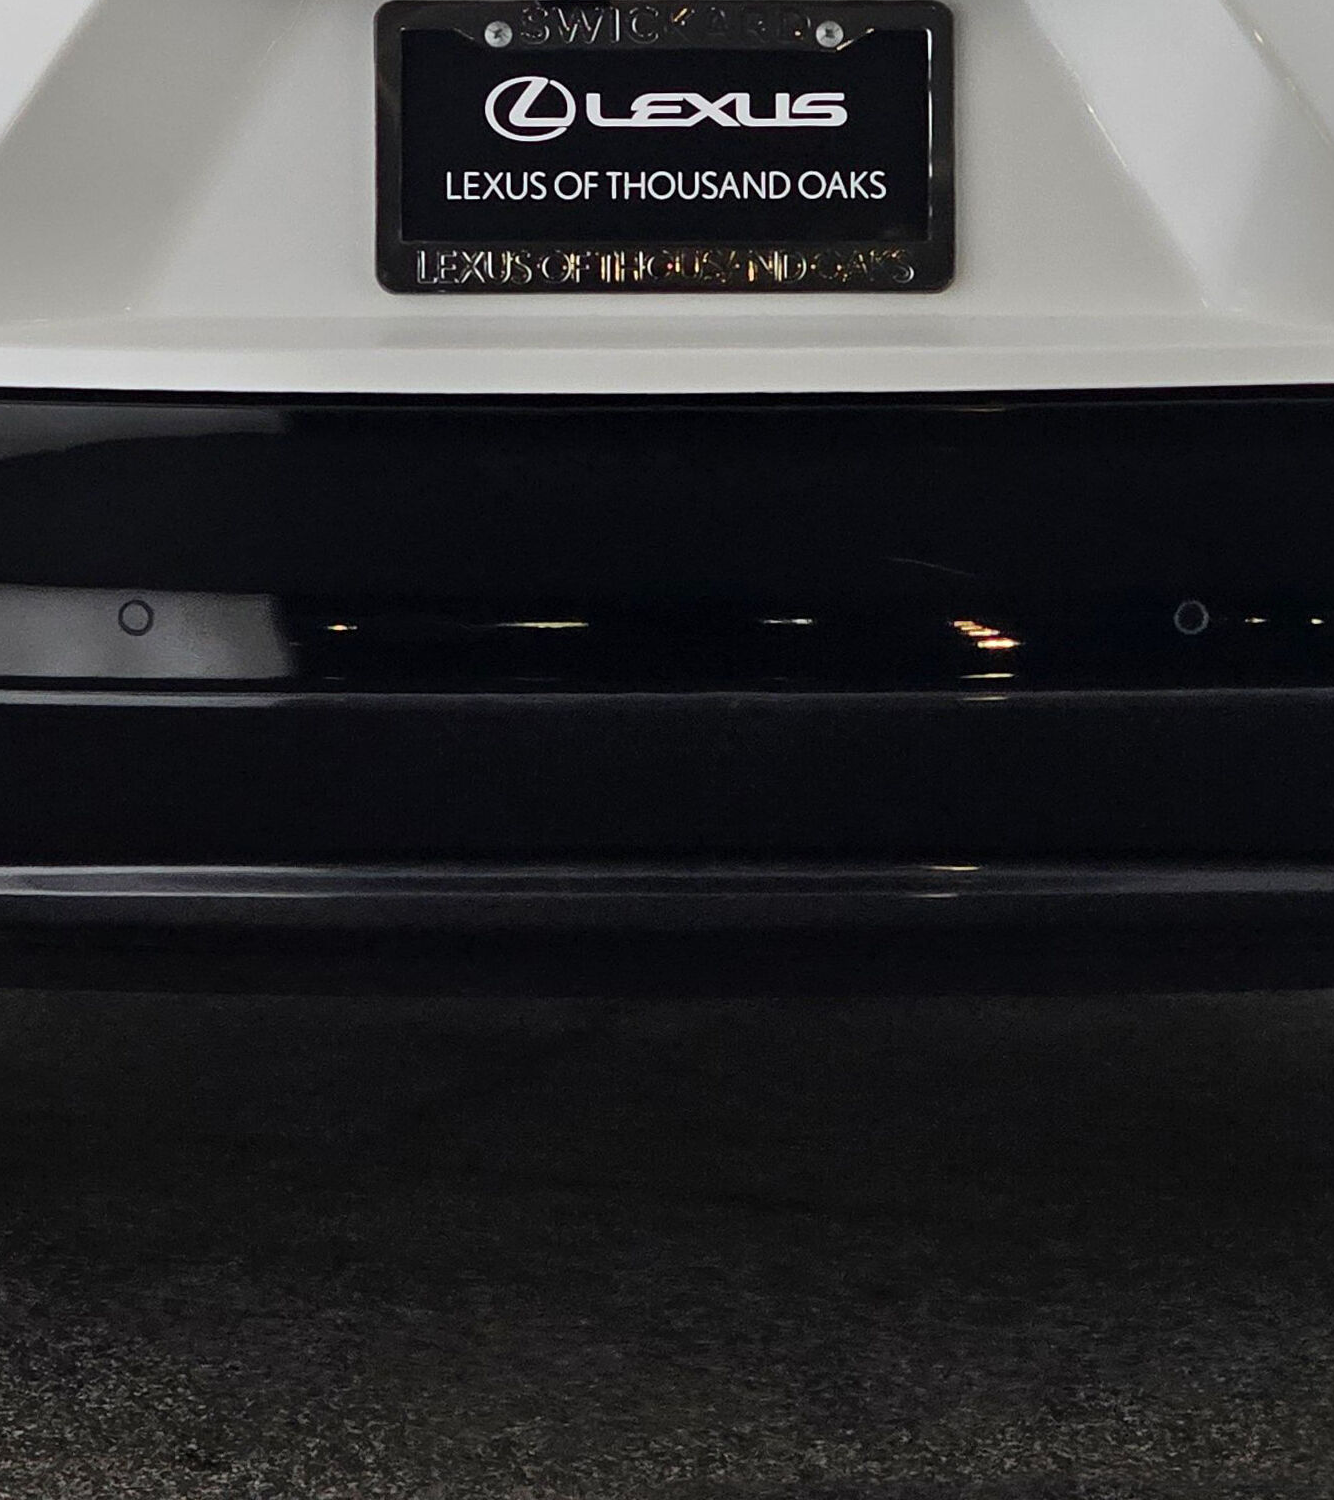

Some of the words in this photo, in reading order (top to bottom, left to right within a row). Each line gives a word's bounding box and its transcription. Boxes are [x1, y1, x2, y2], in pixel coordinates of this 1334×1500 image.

[586, 93, 848, 127] LEXUS
[445, 170, 547, 200] LEXUS
[553, 170, 598, 200] OF
[606, 170, 792, 200] THOUSAND
[797, 170, 887, 200] OAKS
[416, 250, 533, 285] LEXUS
[538, 250, 591, 284] OF
